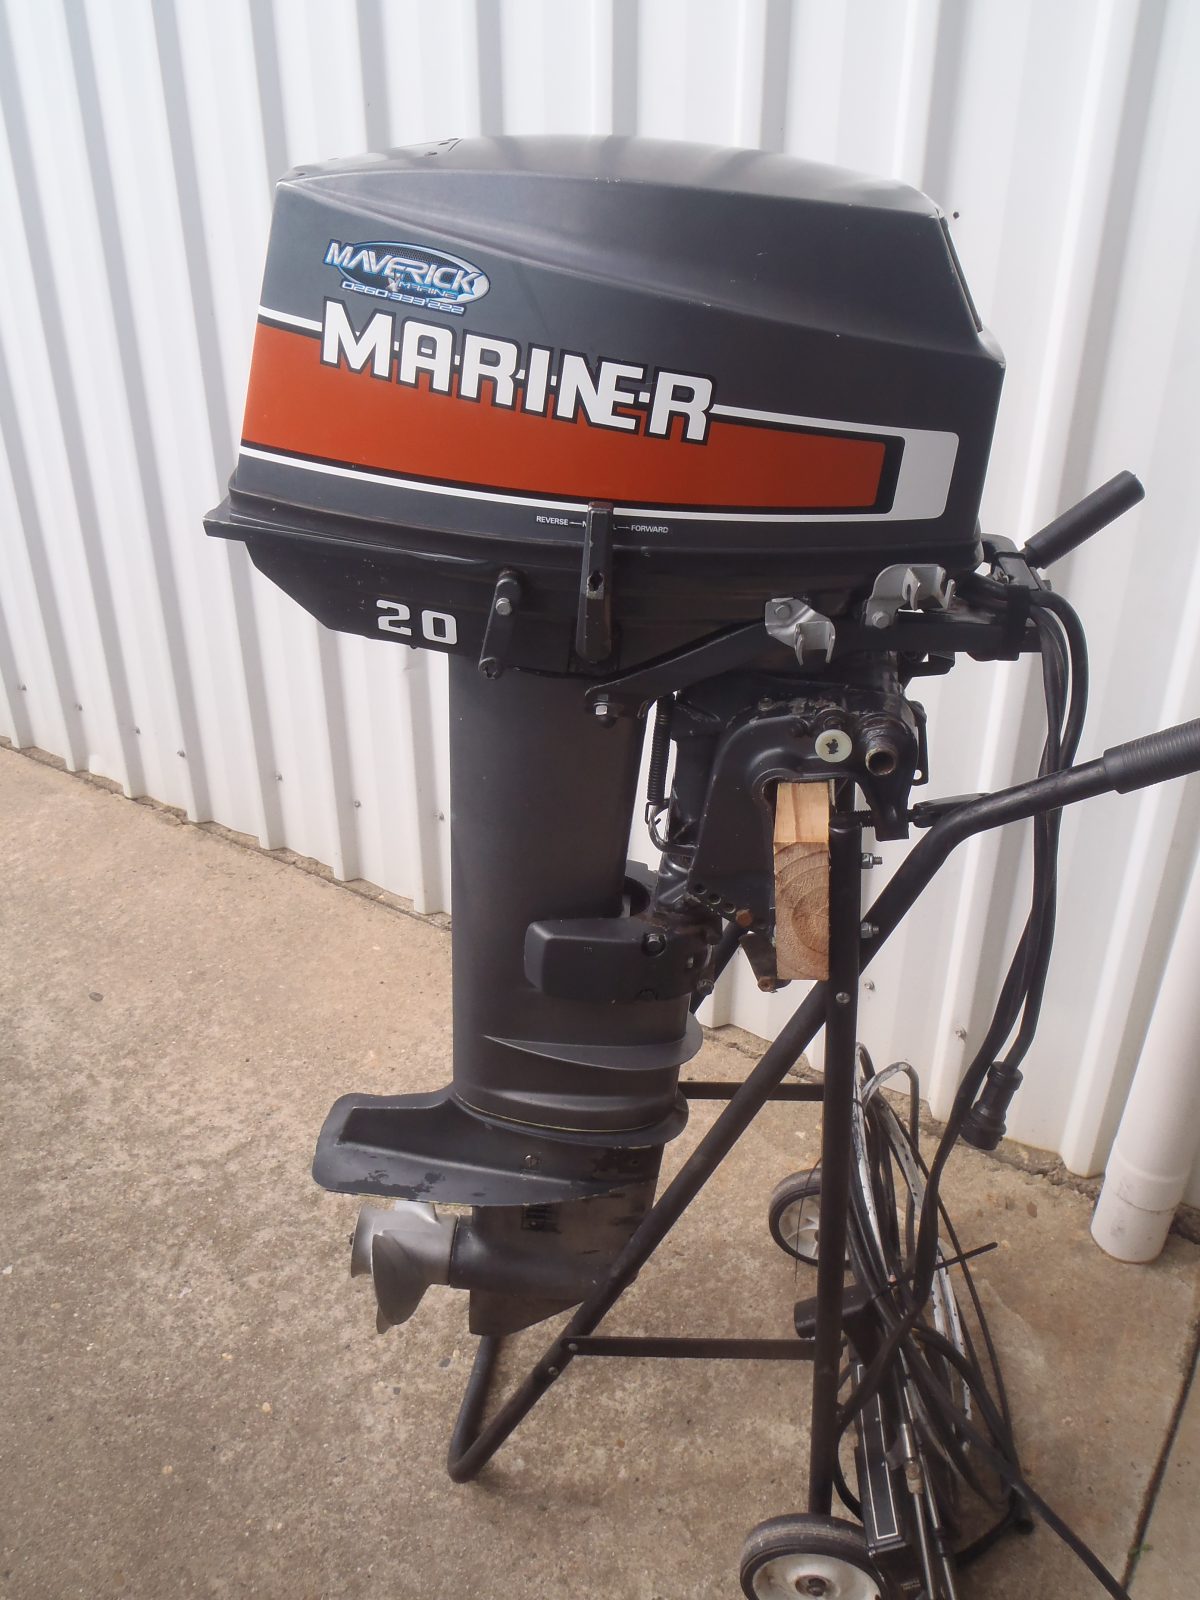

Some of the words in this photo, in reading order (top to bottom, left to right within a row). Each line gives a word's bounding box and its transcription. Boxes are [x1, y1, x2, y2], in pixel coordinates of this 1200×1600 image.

[325, 241, 480, 295] MAVERICK
[322, 300, 712, 441] MARINER
[536, 515, 569, 526] REVERSE
[630, 524, 669, 534] FORWARD
[376, 599, 458, 645] 20
